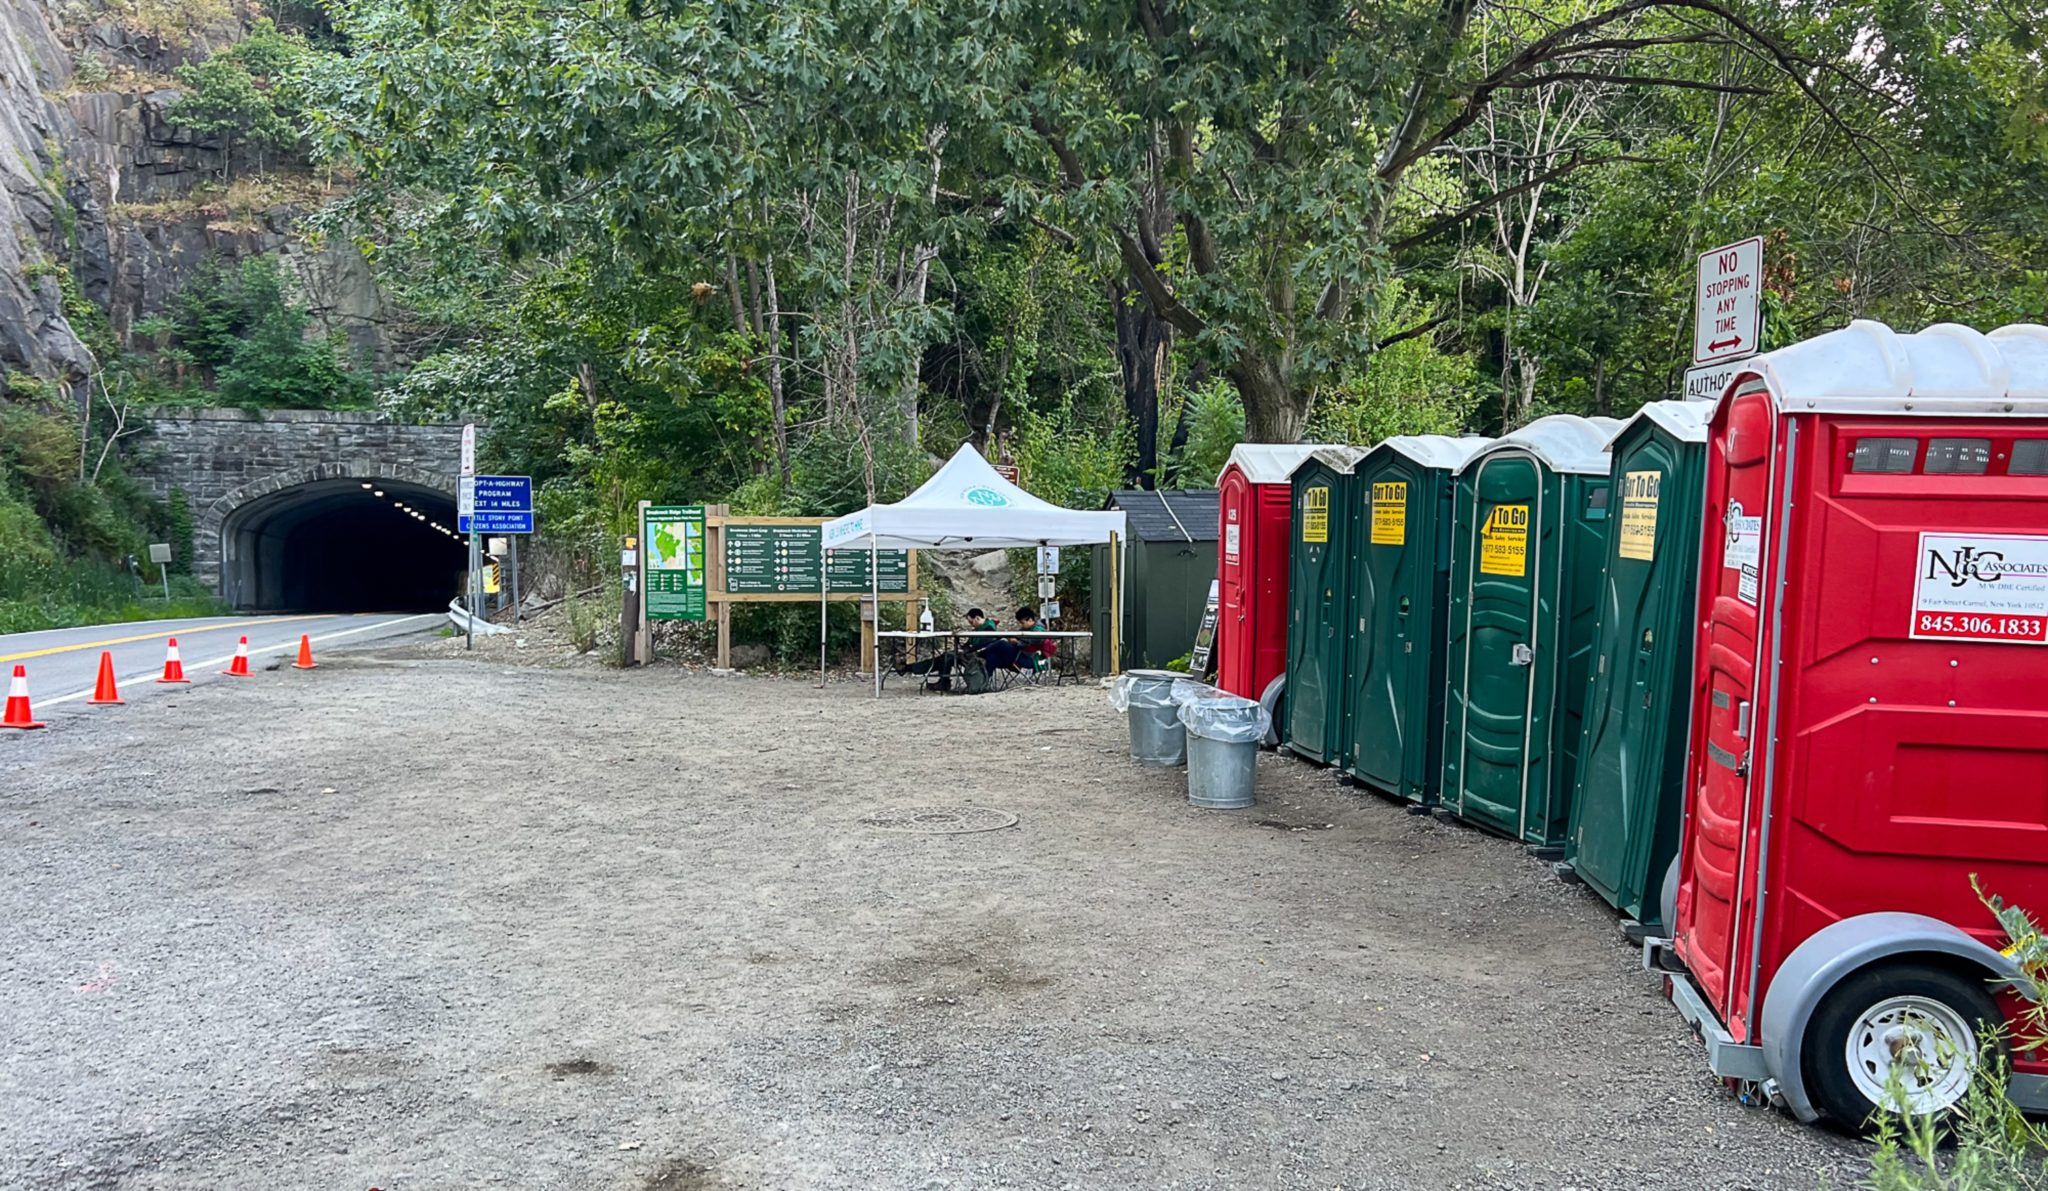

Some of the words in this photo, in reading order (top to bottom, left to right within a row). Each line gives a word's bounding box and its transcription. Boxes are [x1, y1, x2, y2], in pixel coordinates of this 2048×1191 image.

[1718, 251, 1738, 275] NO
[1706, 274, 1750, 298] STOPPING
[1716, 297, 1737, 315] ANY
[1715, 316, 1737, 334] TIME
[1395, 484, 1405, 500] Go
[1646, 474, 1660, 498] Go
[1498, 507, 1509, 525] To
[1511, 507, 1526, 525] Go
[1990, 600, 2004, 608] New
[2007, 601, 2022, 609] York
[1920, 614, 2041, 636] 845.306.1833
